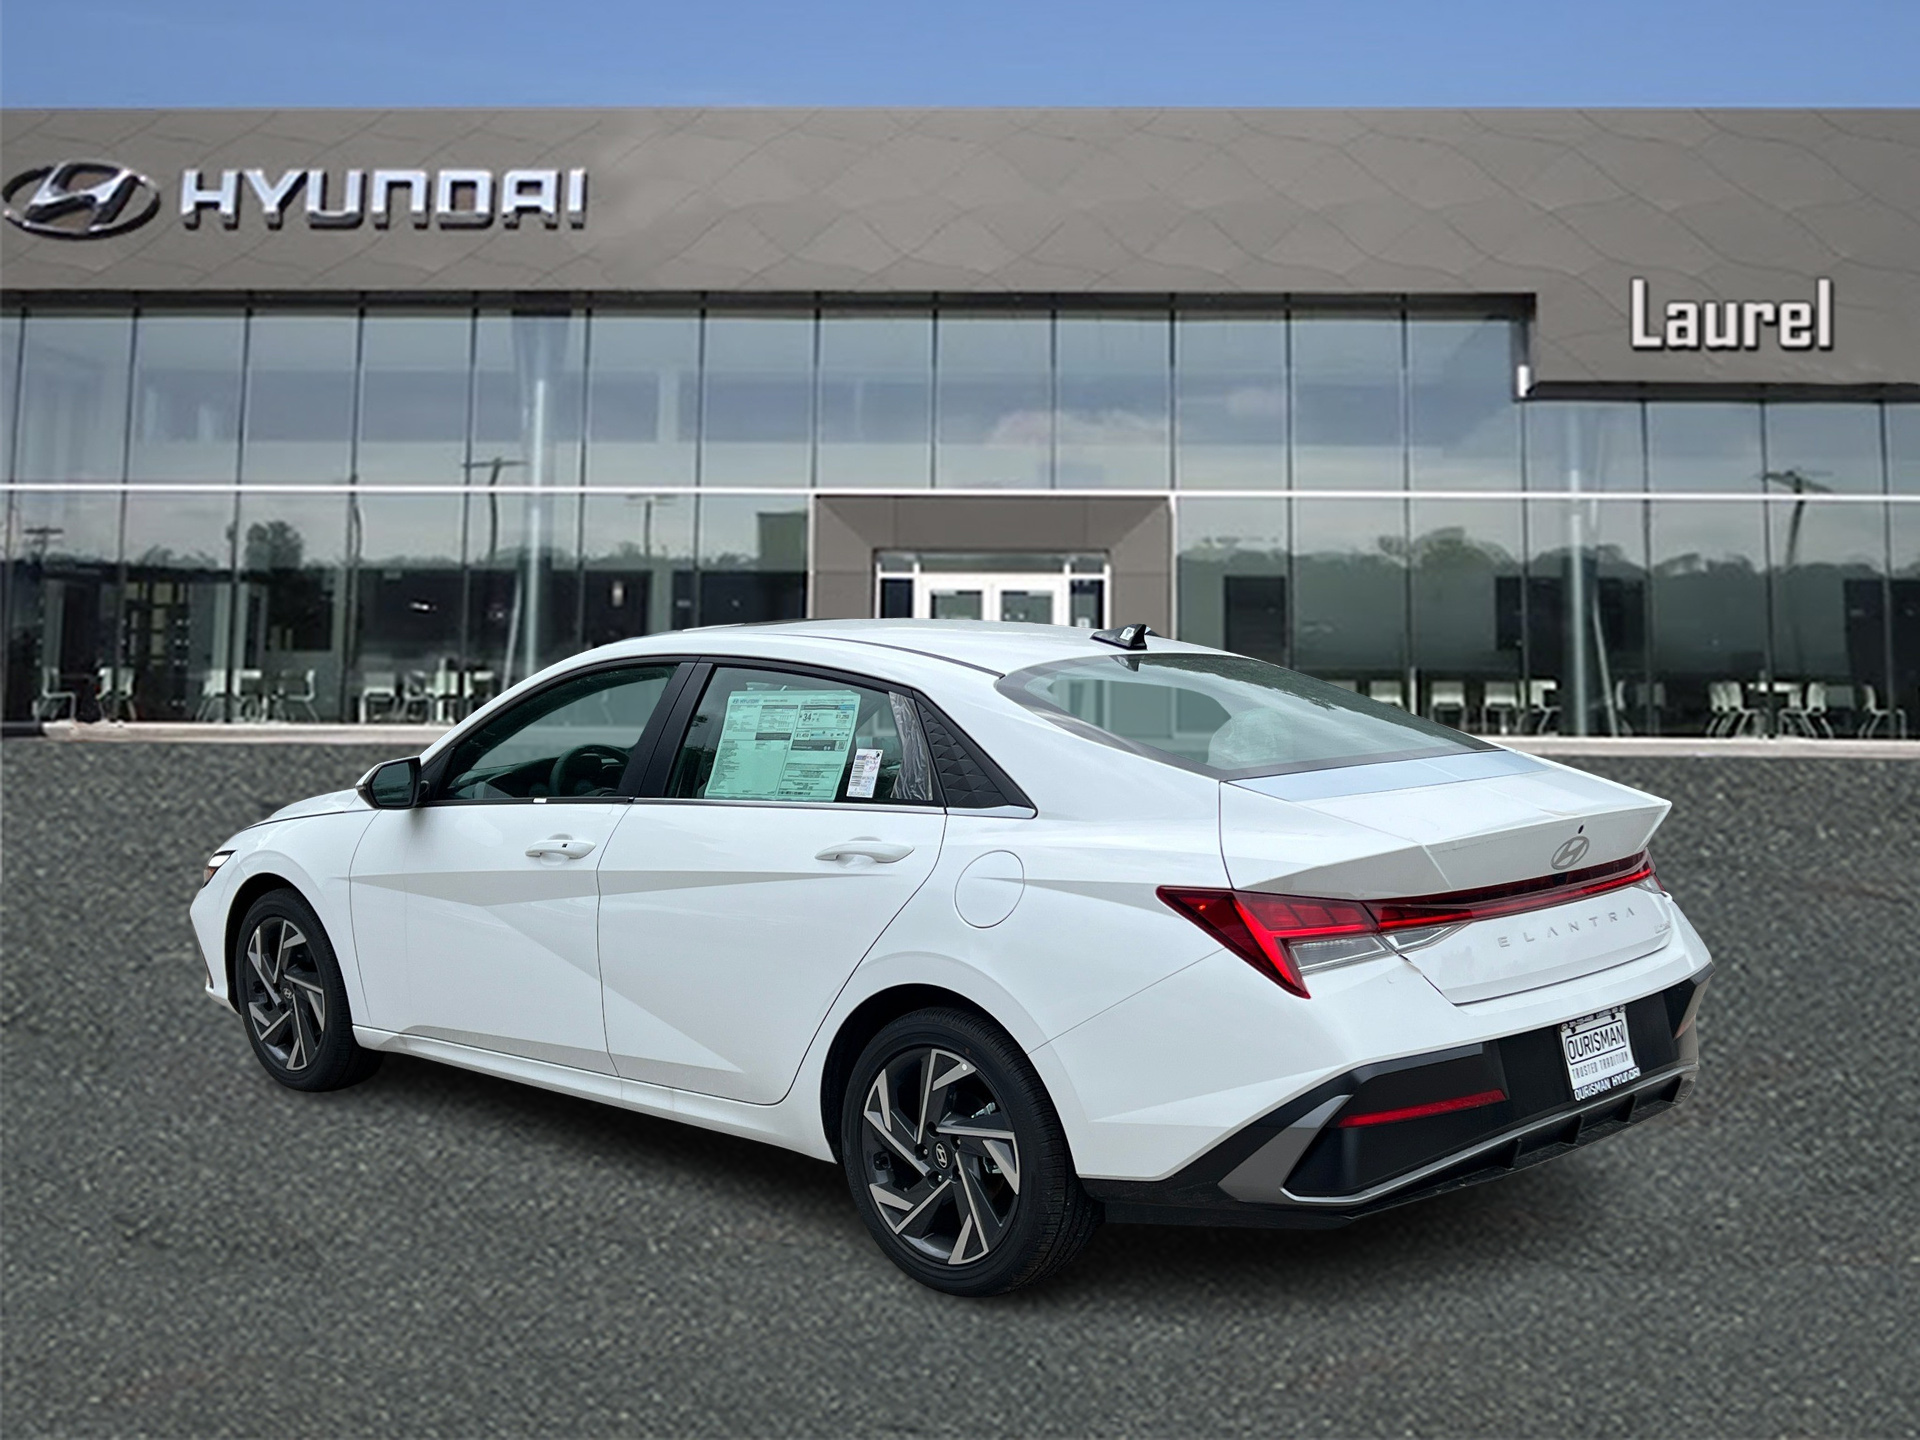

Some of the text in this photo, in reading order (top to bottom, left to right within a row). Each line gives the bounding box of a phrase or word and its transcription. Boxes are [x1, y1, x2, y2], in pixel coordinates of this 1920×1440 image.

[179, 168, 588, 229] HYUNDAI
[1631, 278, 1832, 348] Laurel
[1497, 907, 1635, 948] ELANTRA
[1567, 1024, 1625, 1060] OURISMAN
[1571, 1061, 1598, 1080] TRUSTED
[1573, 1078, 1612, 1102] OURISMAN
